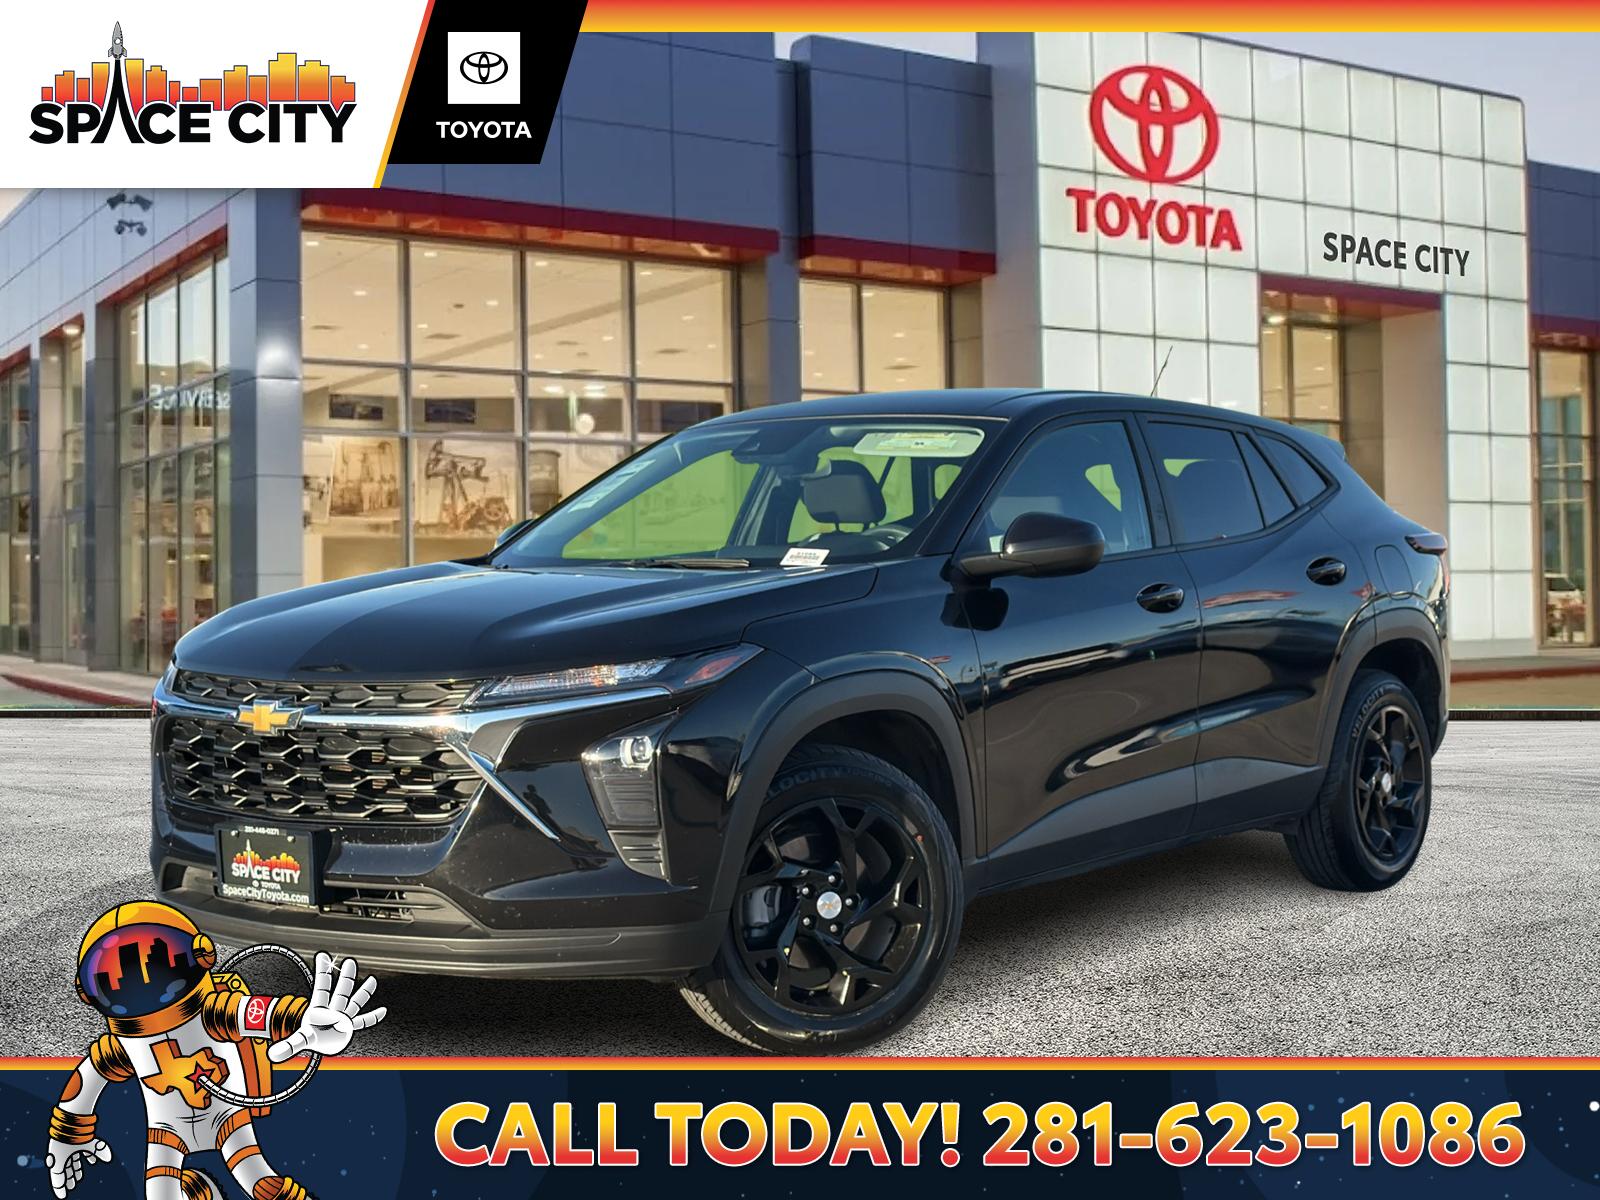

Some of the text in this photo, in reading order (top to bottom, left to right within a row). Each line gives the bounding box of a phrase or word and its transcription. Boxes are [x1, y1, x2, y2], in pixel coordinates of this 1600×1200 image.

[1066, 187, 1242, 251] TOYOTA
[1323, 232, 1470, 277] SPACE CITY
[231, 856, 301, 884] SPACE CITY
[222, 884, 310, 904] SpaceCityToyota.com
[261, 881, 281, 891] TOYOTA
